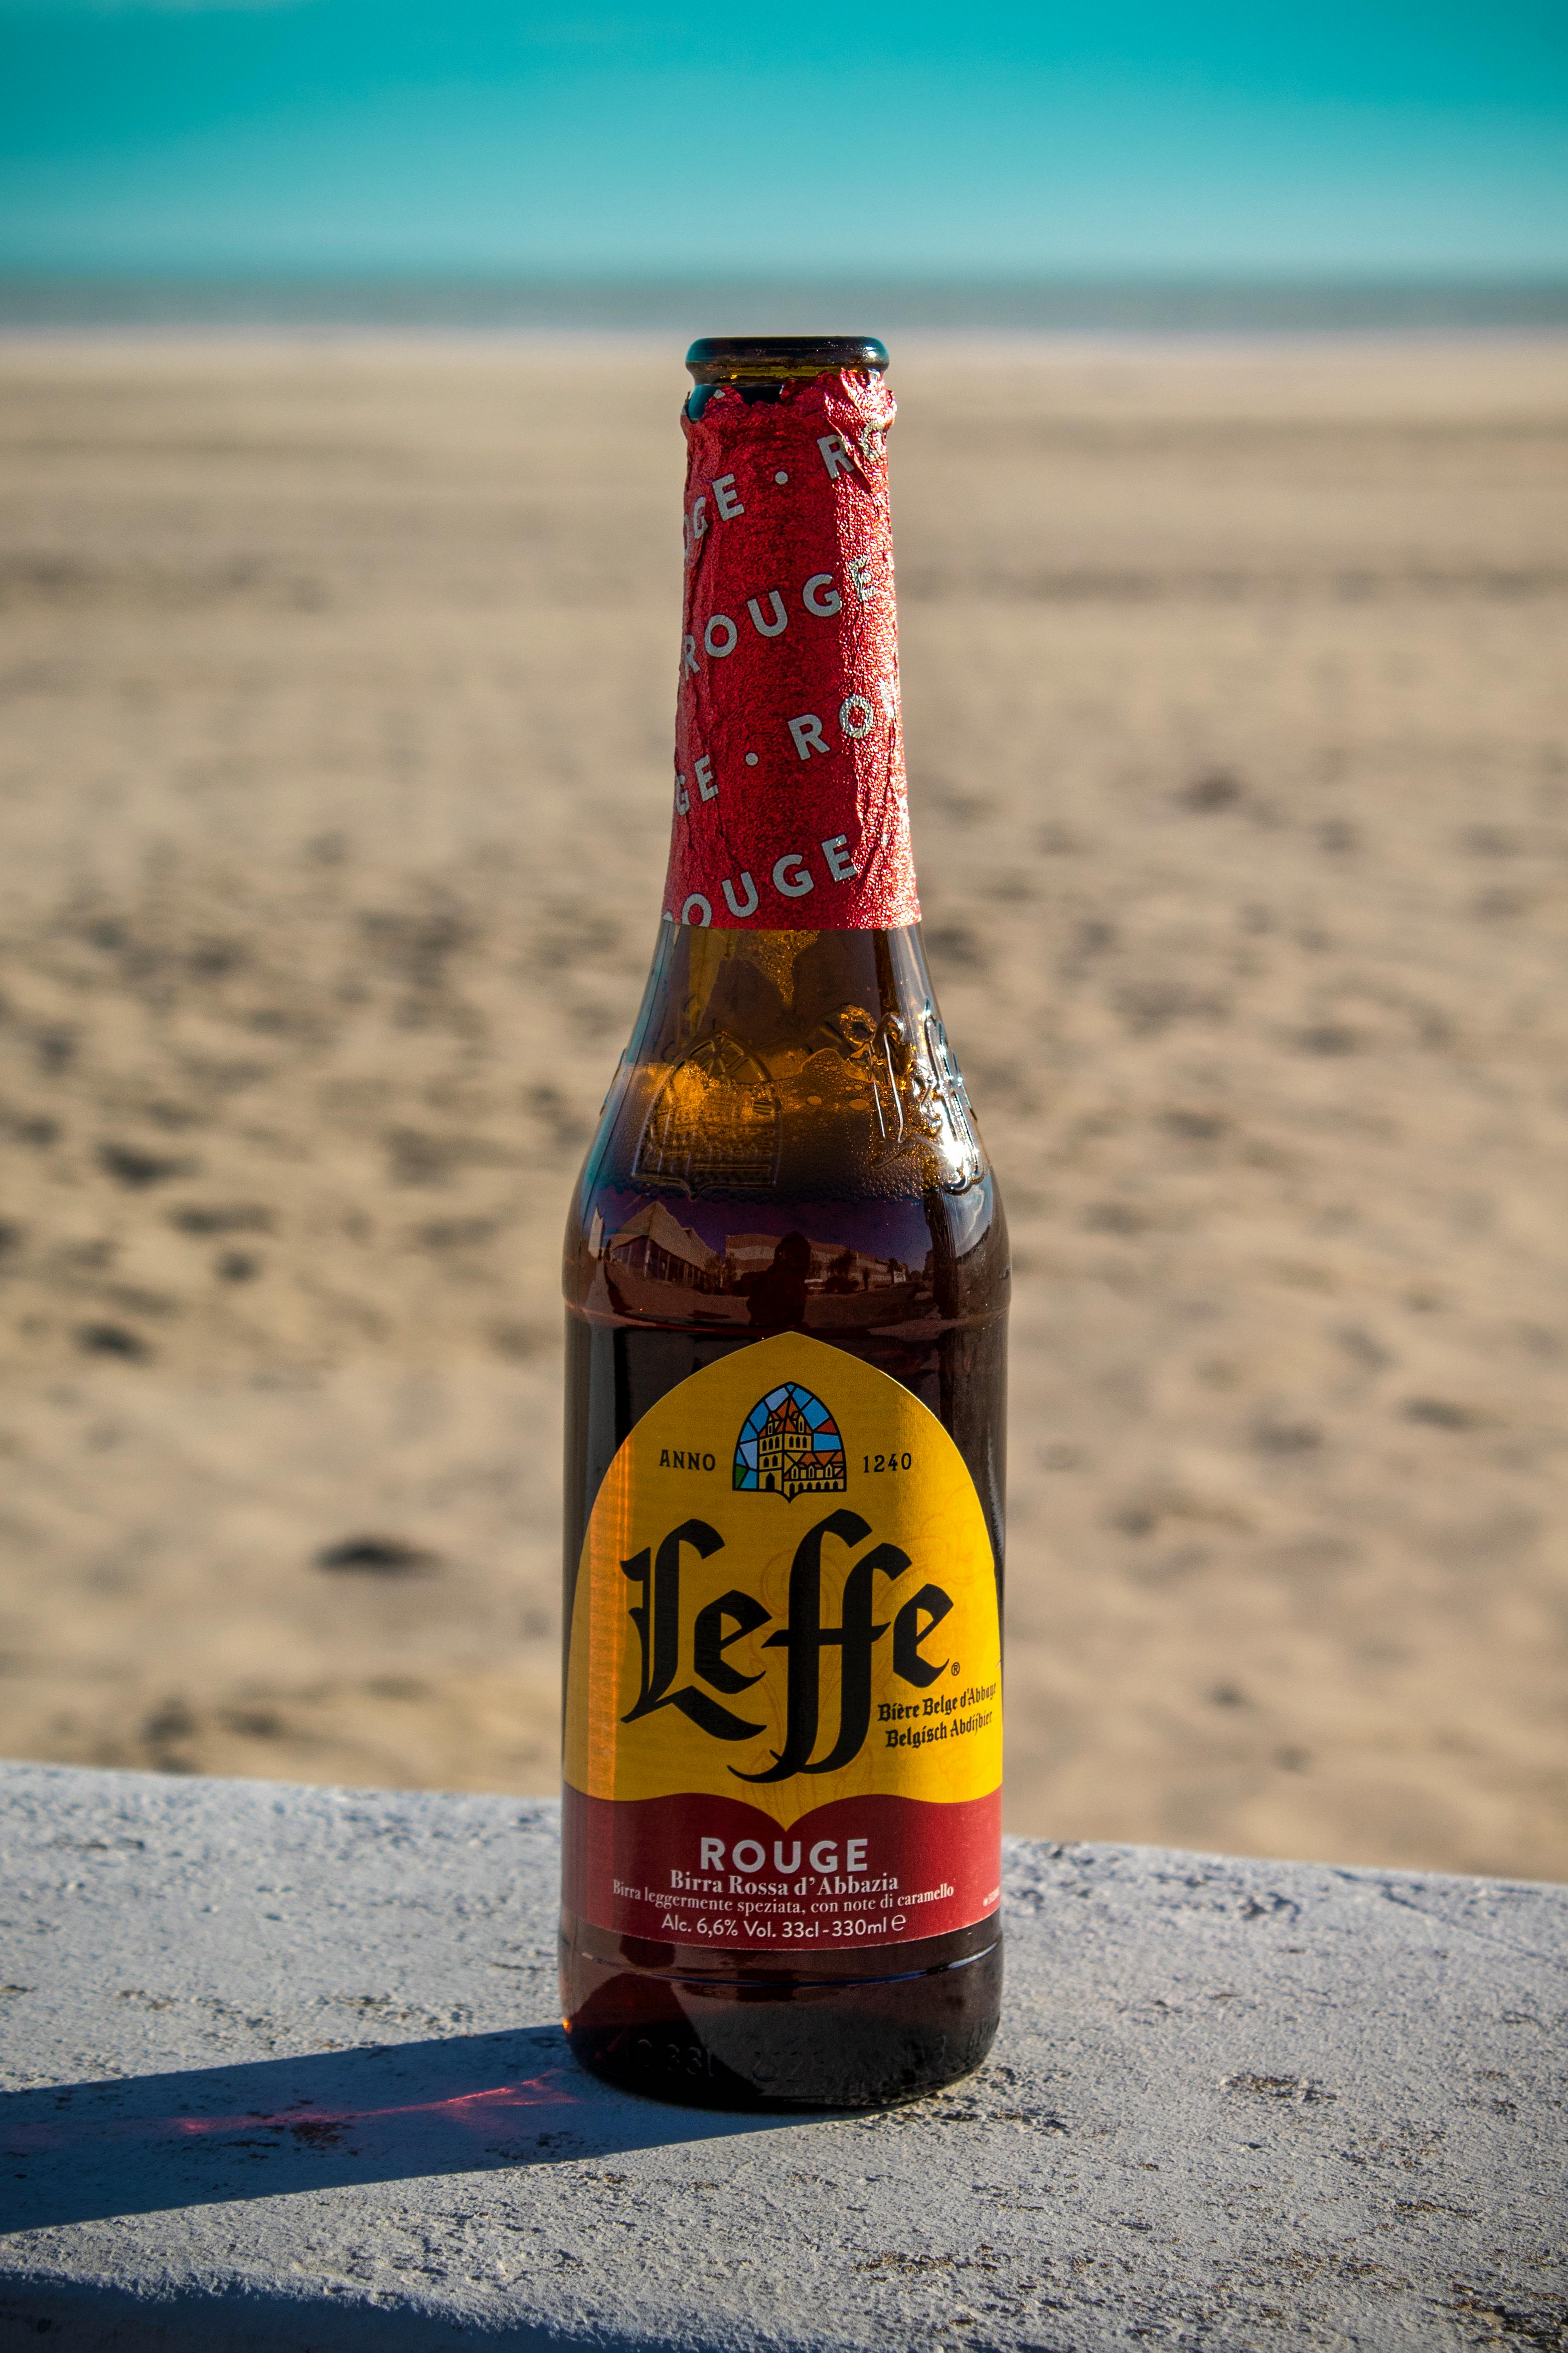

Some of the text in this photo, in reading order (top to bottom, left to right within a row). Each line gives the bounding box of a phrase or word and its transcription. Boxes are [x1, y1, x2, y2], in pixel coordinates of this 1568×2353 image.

[663, 834, 860, 927] OUGE
[659, 1449, 912, 1474] ANNO 1240
[620, 1508, 955, 1784] Leffe
[877, 1703, 920, 1722] Bière
[922, 1694, 958, 1716] Belge
[885, 1721, 948, 1748] Belgisch
[700, 1837, 868, 1874] ROUGE
[670, 1869, 724, 1893] Birra
[728, 1875, 790, 1896] Rossa
[612, 1879, 955, 1917] Birra leggermente speziata, con note di caramello
[661, 1913, 692, 1933] Alc.
[696, 1918, 738, 1938] 6,6%
[743, 1920, 776, 1938] Vol.
